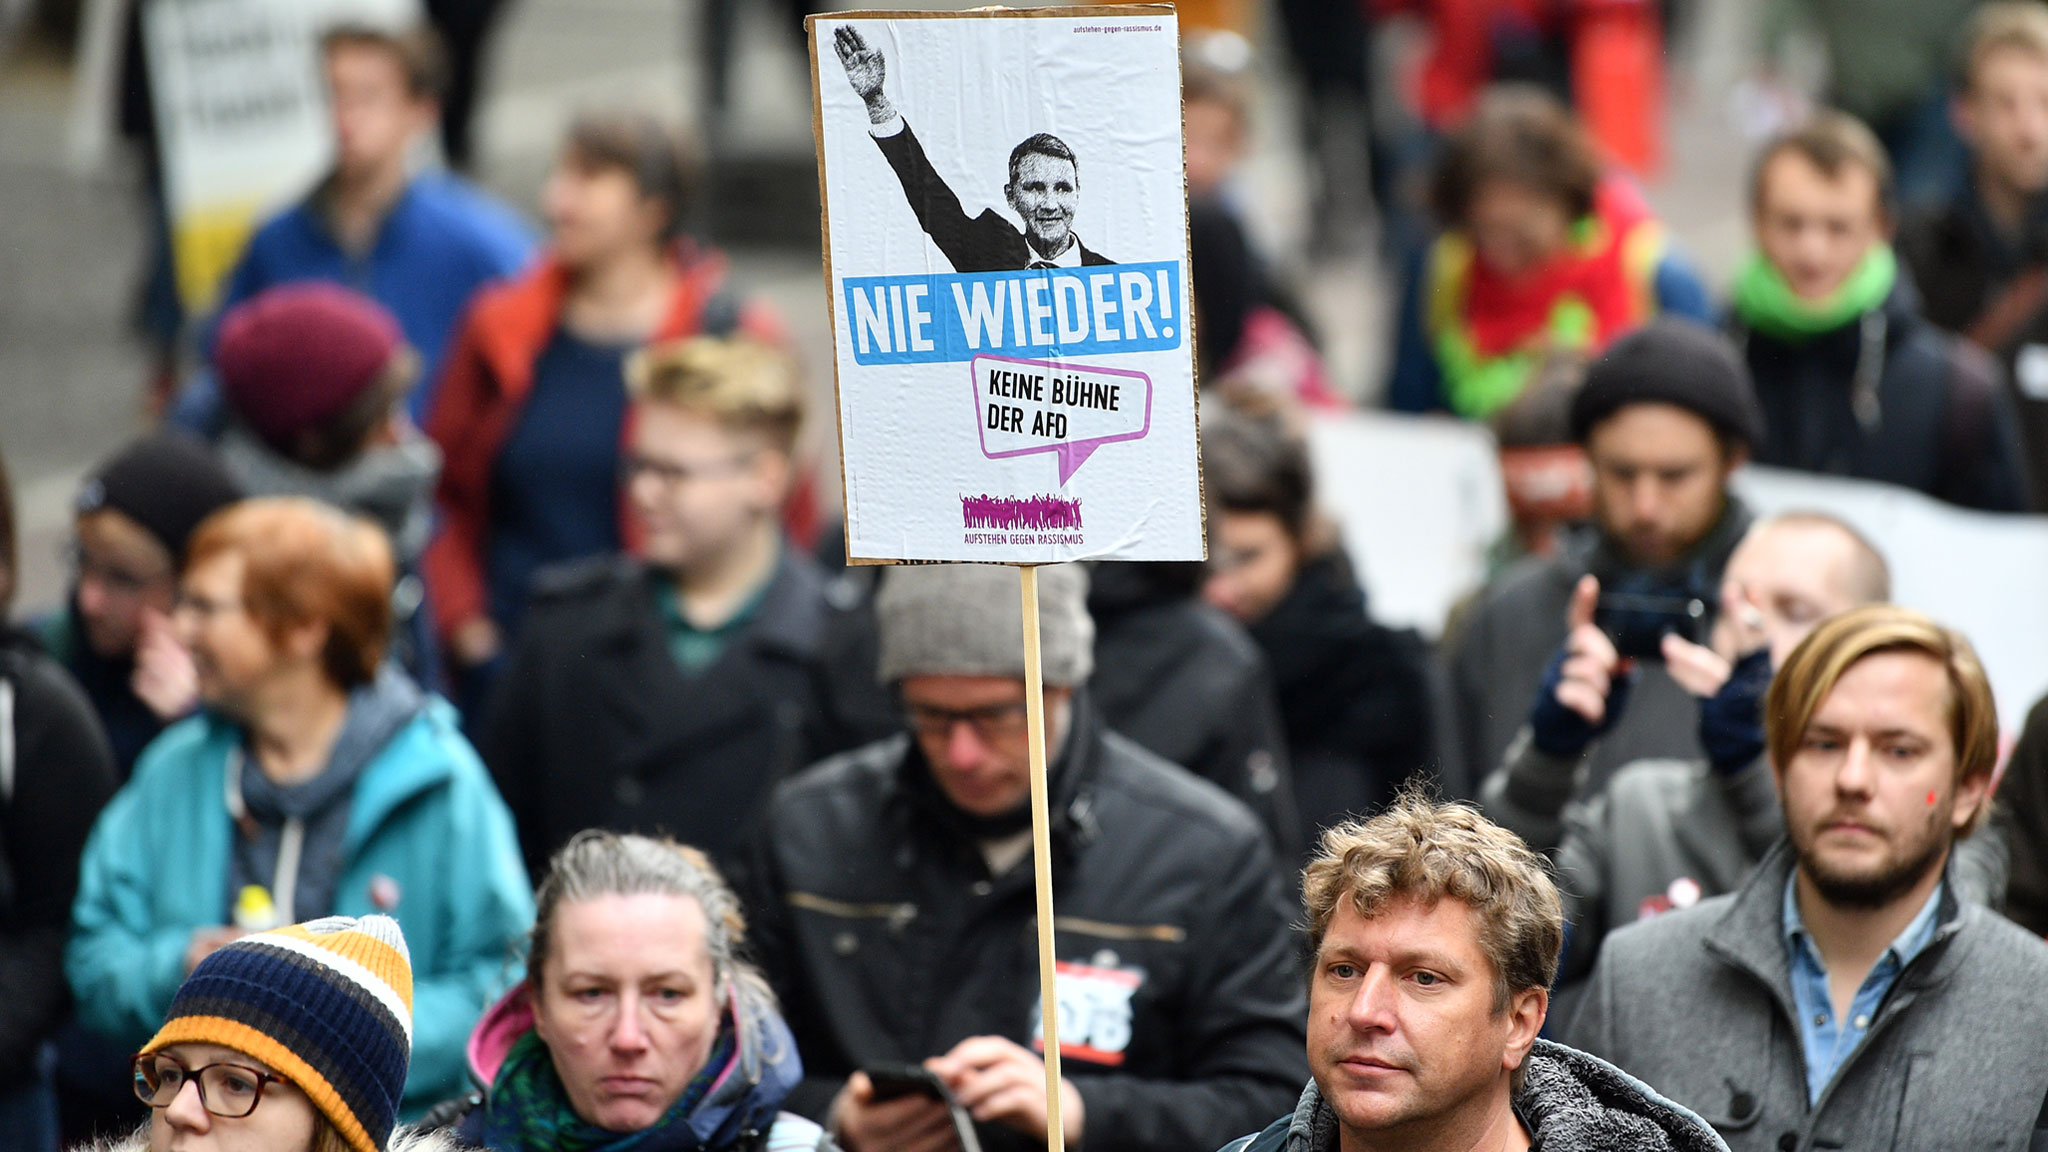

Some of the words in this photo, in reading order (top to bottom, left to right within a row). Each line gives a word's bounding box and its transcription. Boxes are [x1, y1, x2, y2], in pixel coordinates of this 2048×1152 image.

[852, 284, 935, 354] NIE
[951, 269, 1175, 349] WIEDER!
[989, 369, 1044, 402] KEINE
[1051, 374, 1120, 412] BÜHNE
[987, 403, 1024, 434] DER
[1031, 410, 1067, 439] AFD
[964, 533, 1007, 544] AUFSTEHEN
[1010, 534, 1035, 545] GEGEN
[1038, 534, 1084, 544] RASSISMUS
